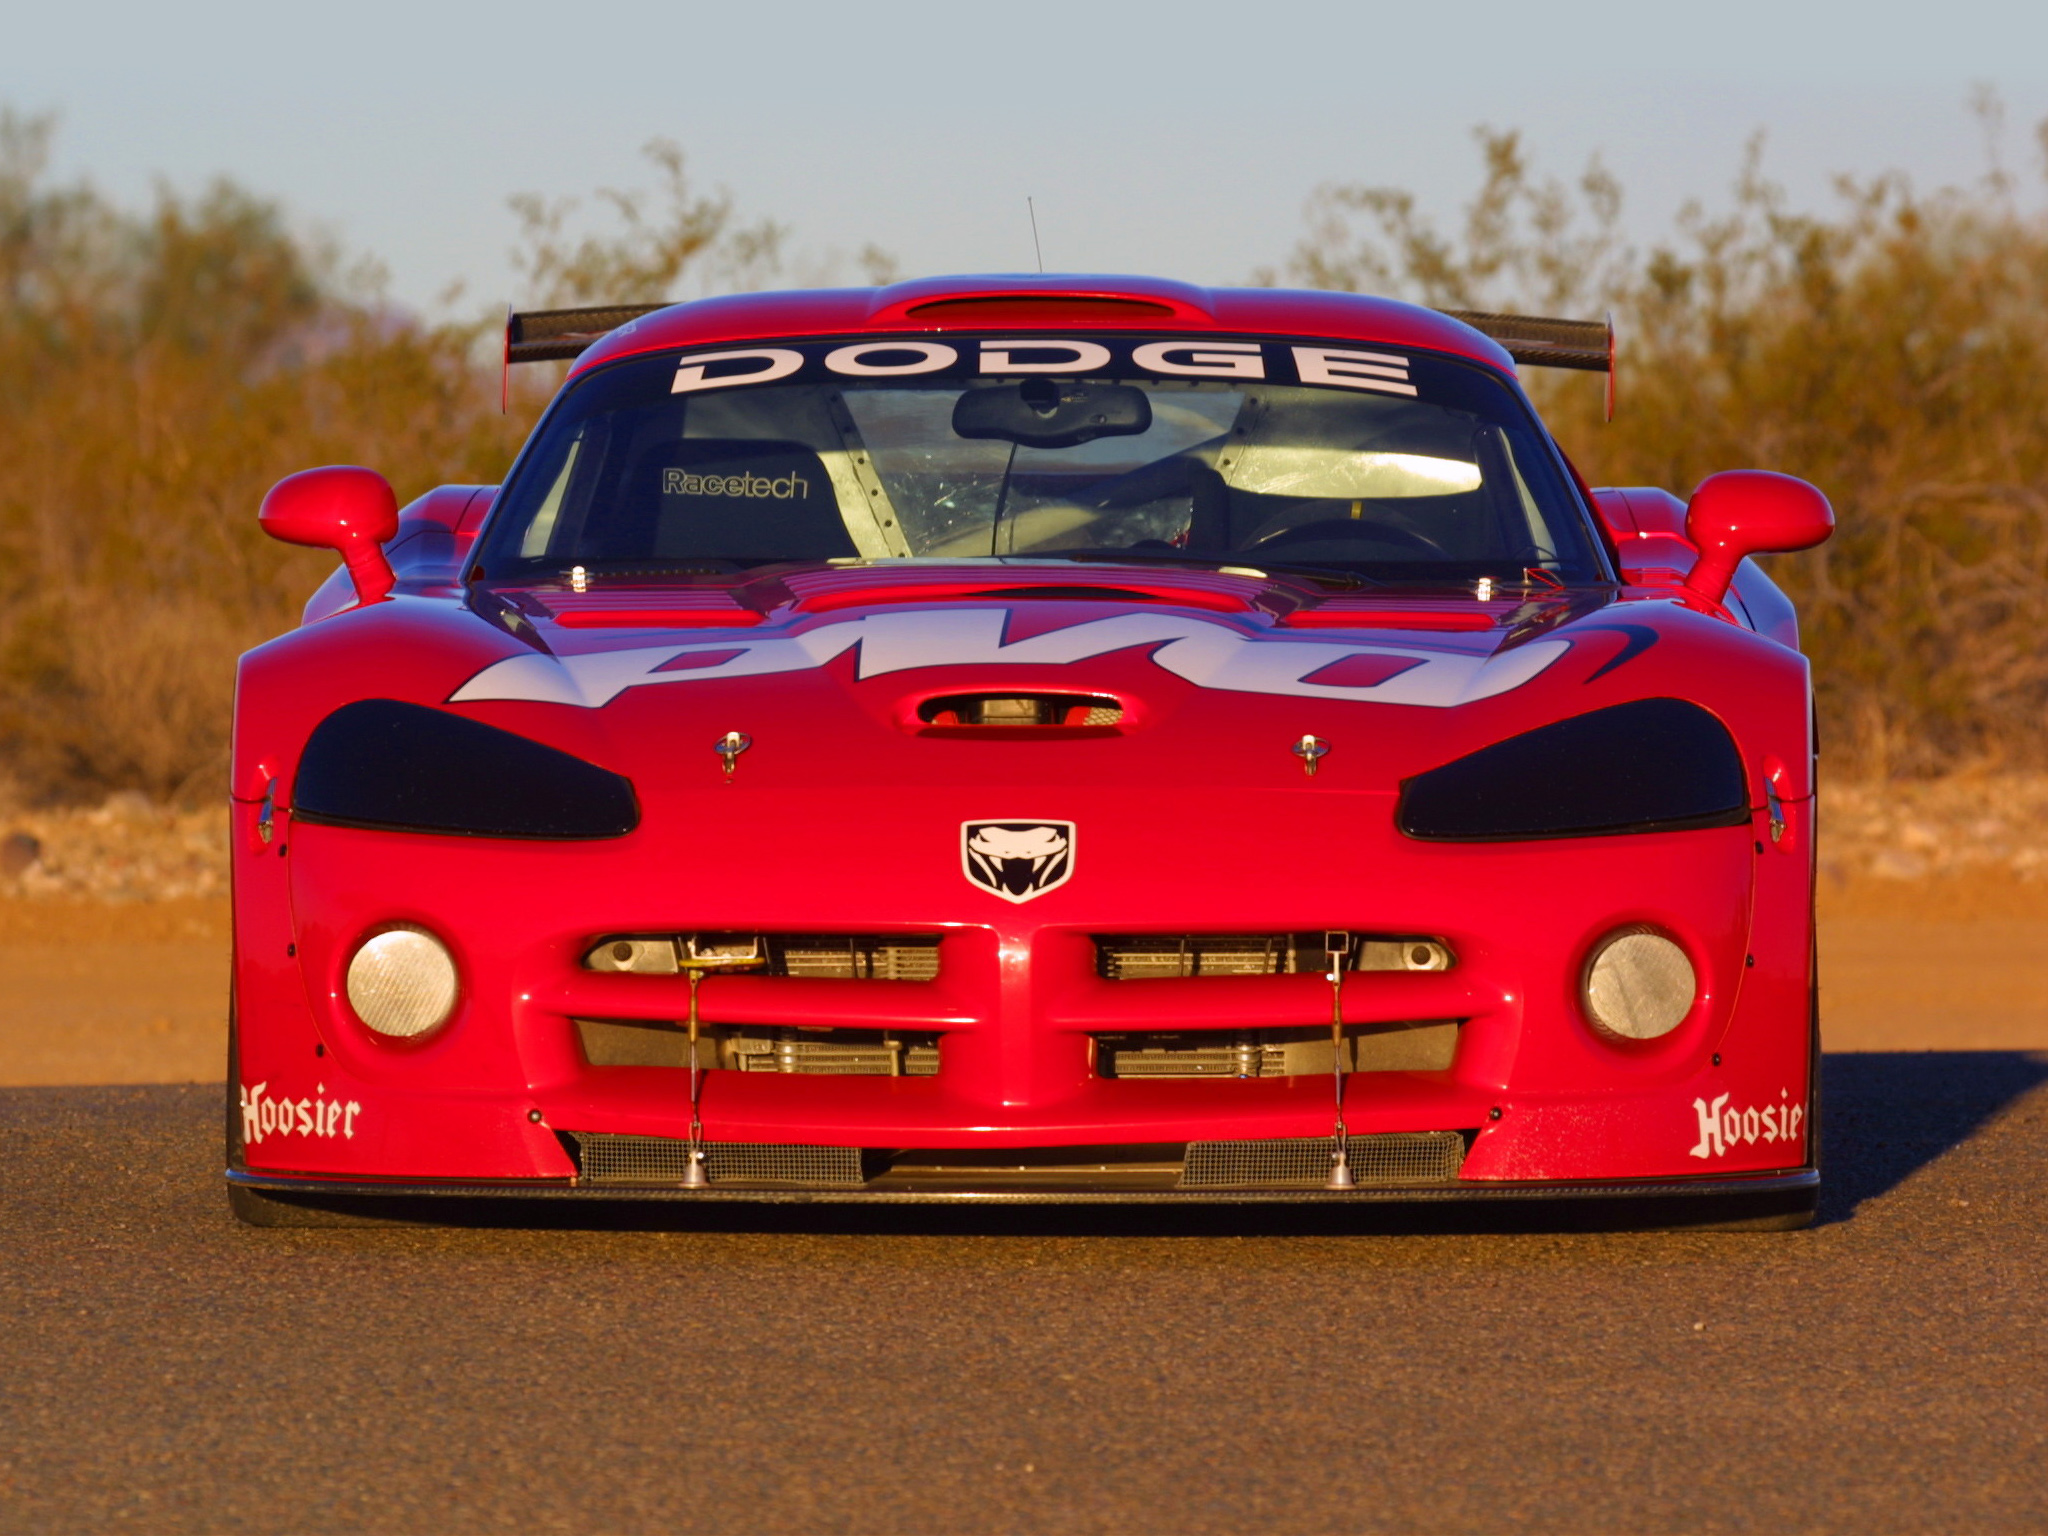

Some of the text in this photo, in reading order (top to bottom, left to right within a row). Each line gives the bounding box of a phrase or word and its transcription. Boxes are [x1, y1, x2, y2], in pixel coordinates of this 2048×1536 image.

[671, 339, 1418, 397] DODGE
[662, 467, 808, 499] Racetech
[240, 1081, 361, 1144] Hoosier
[1689, 1086, 1806, 1160] Hoosie
